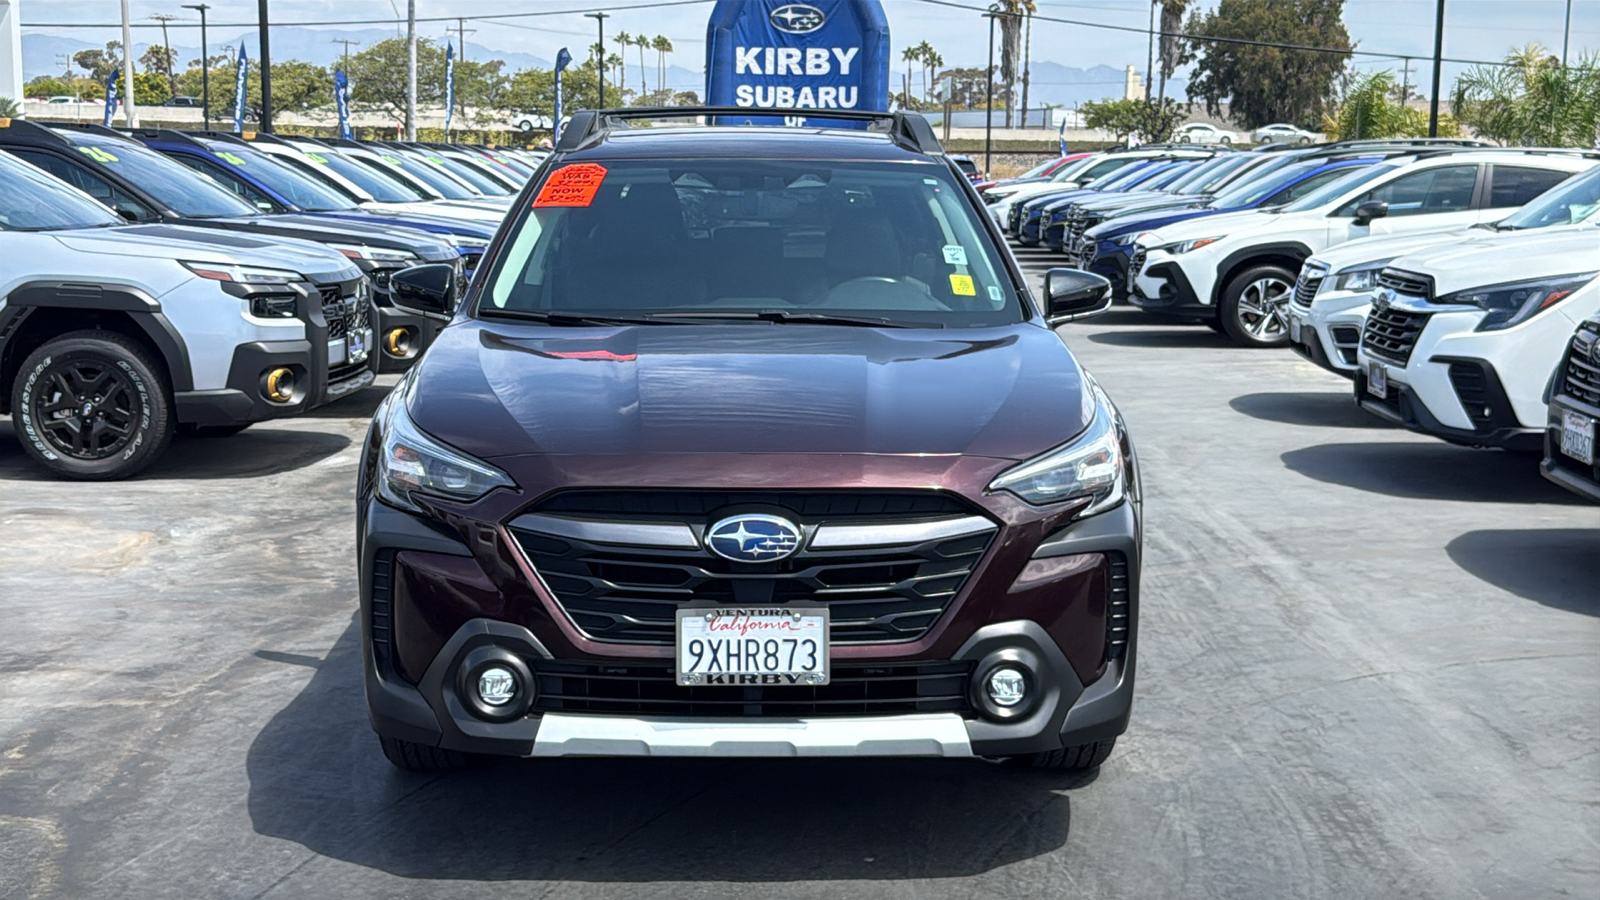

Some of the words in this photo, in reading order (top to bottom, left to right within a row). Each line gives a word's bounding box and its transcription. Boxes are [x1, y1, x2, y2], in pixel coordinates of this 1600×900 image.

[735, 46, 859, 76] KIRBY
[736, 84, 858, 109] SUBARU
[78, 145, 119, 163] 26
[709, 615, 802, 636] California
[688, 639, 817, 672] 9XHR873
[706, 673, 802, 684] KIRBY
